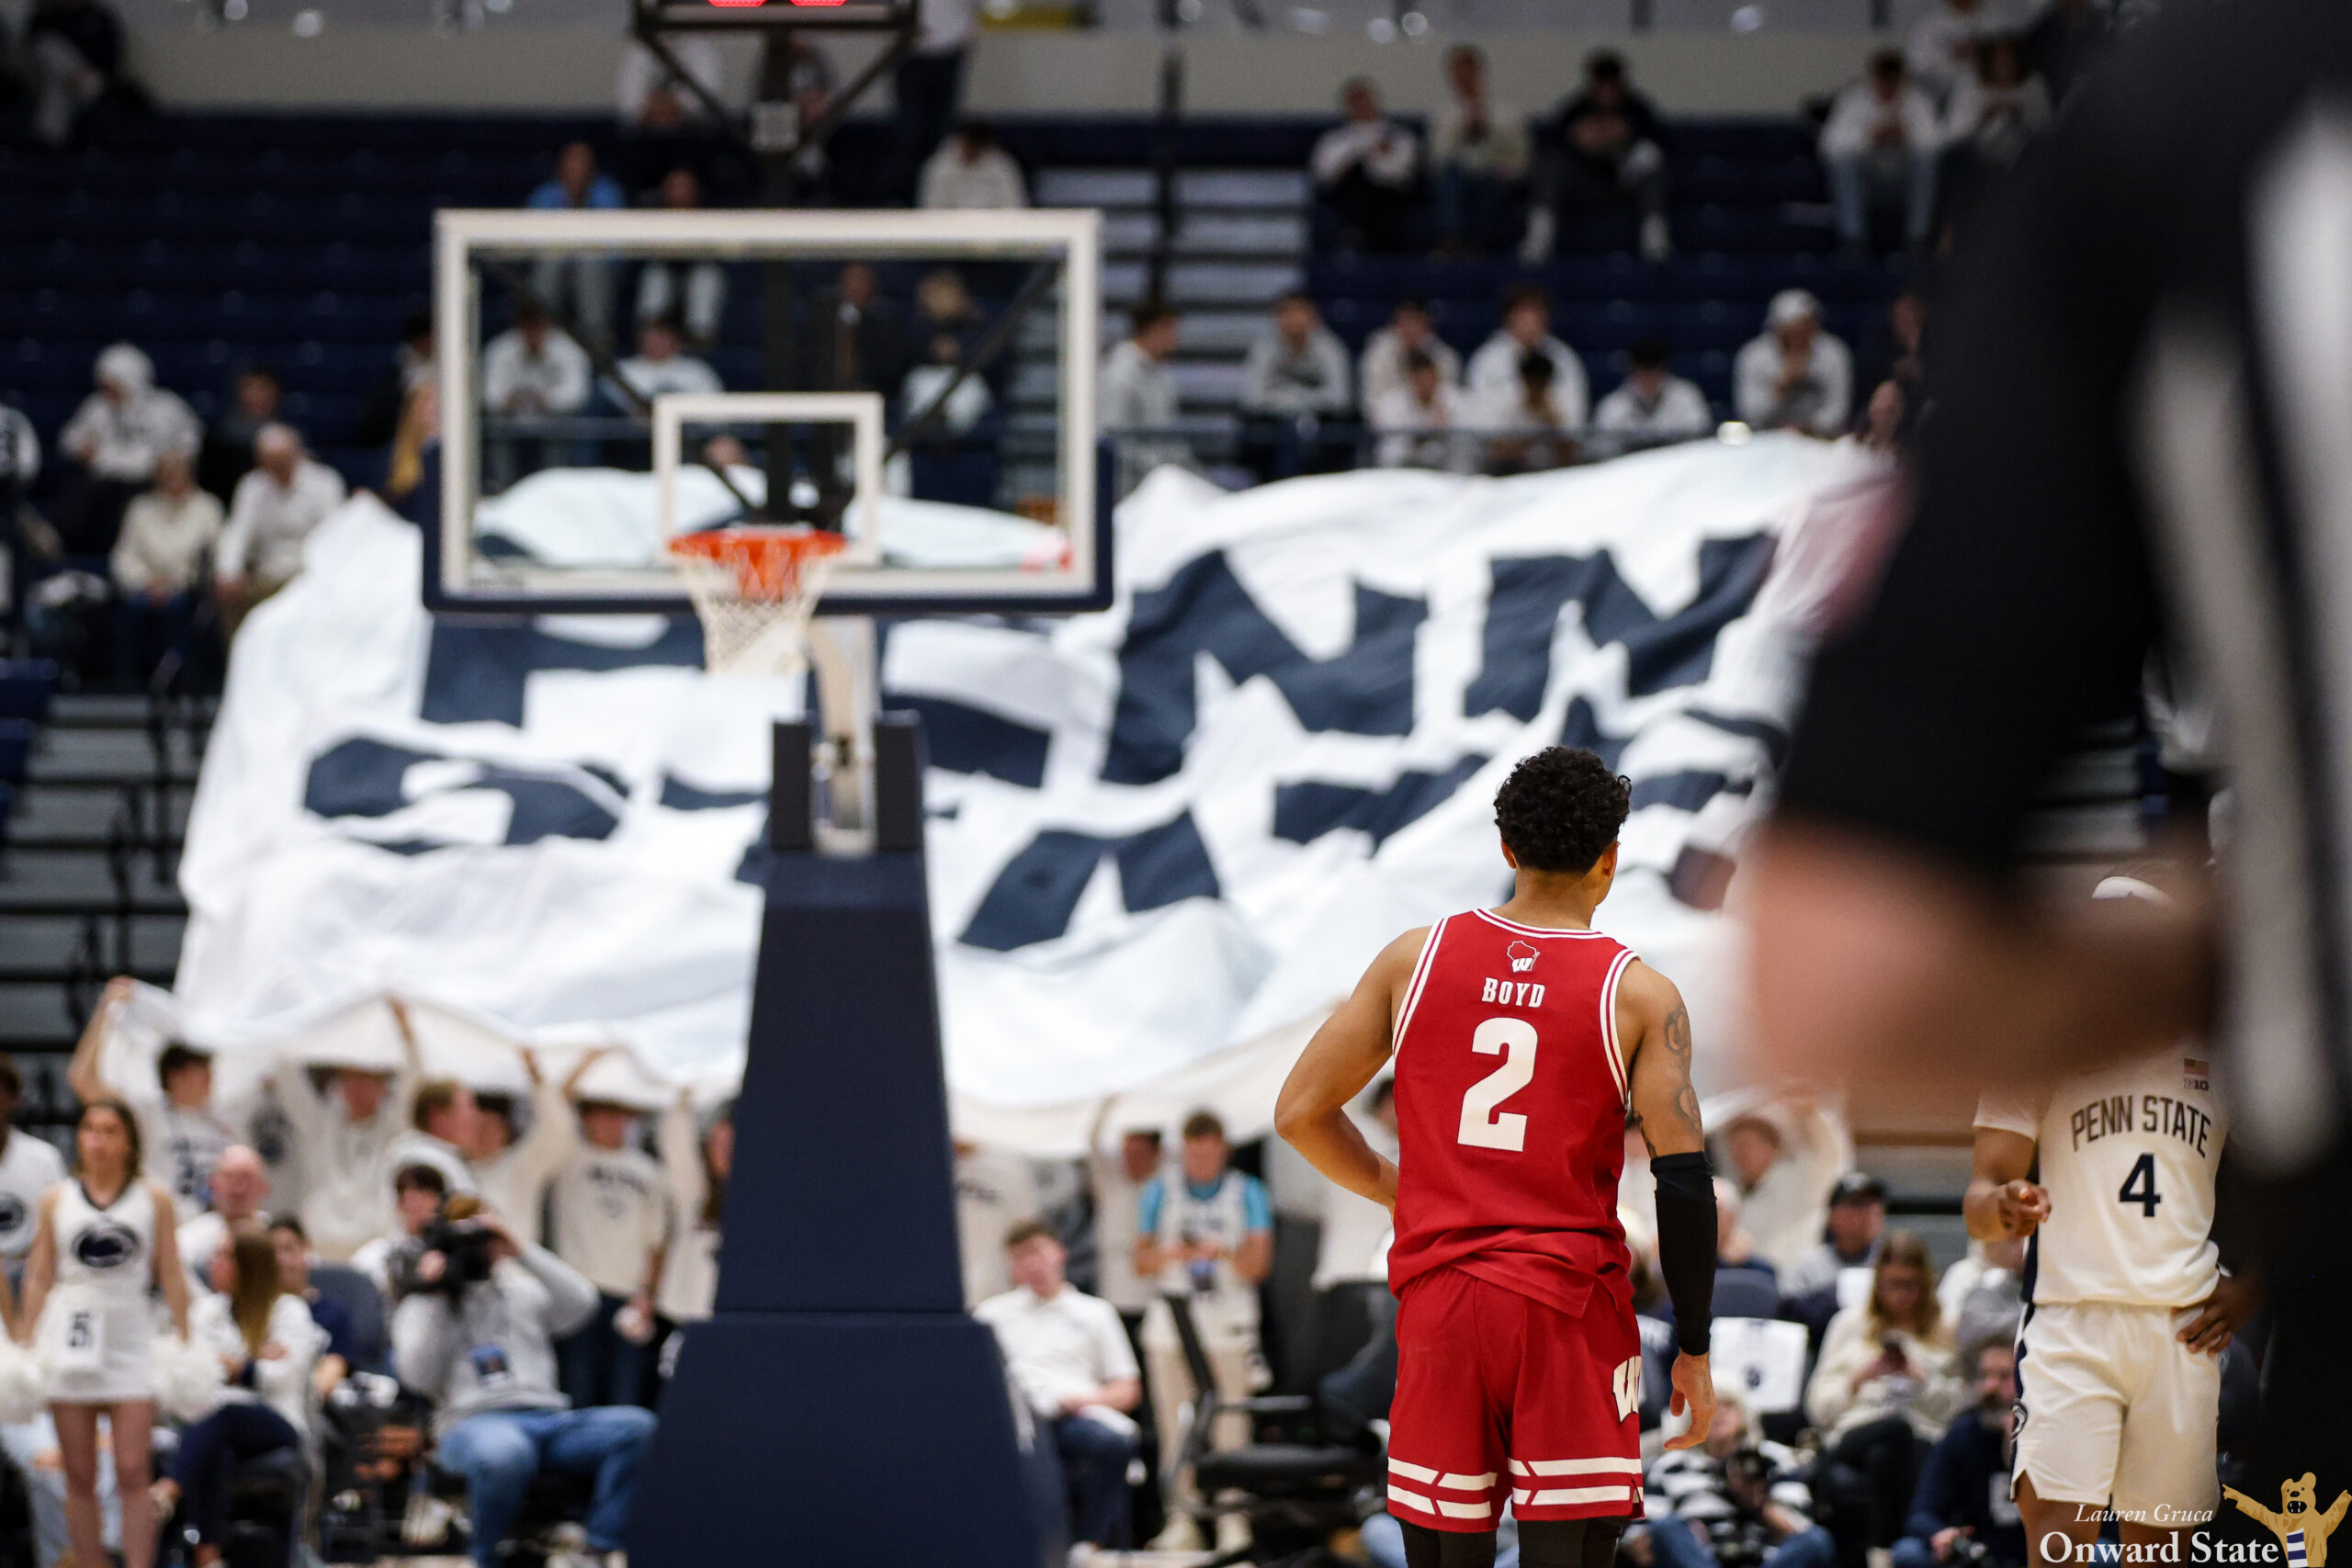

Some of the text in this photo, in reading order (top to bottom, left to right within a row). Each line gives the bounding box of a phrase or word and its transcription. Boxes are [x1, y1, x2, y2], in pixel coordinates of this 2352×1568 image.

[1481, 976, 1546, 1009] BOYD
[1457, 1016, 1539, 1153] 2
[2070, 1094, 2211, 1159] PENN STATE
[2119, 1152, 2162, 1218] 4
